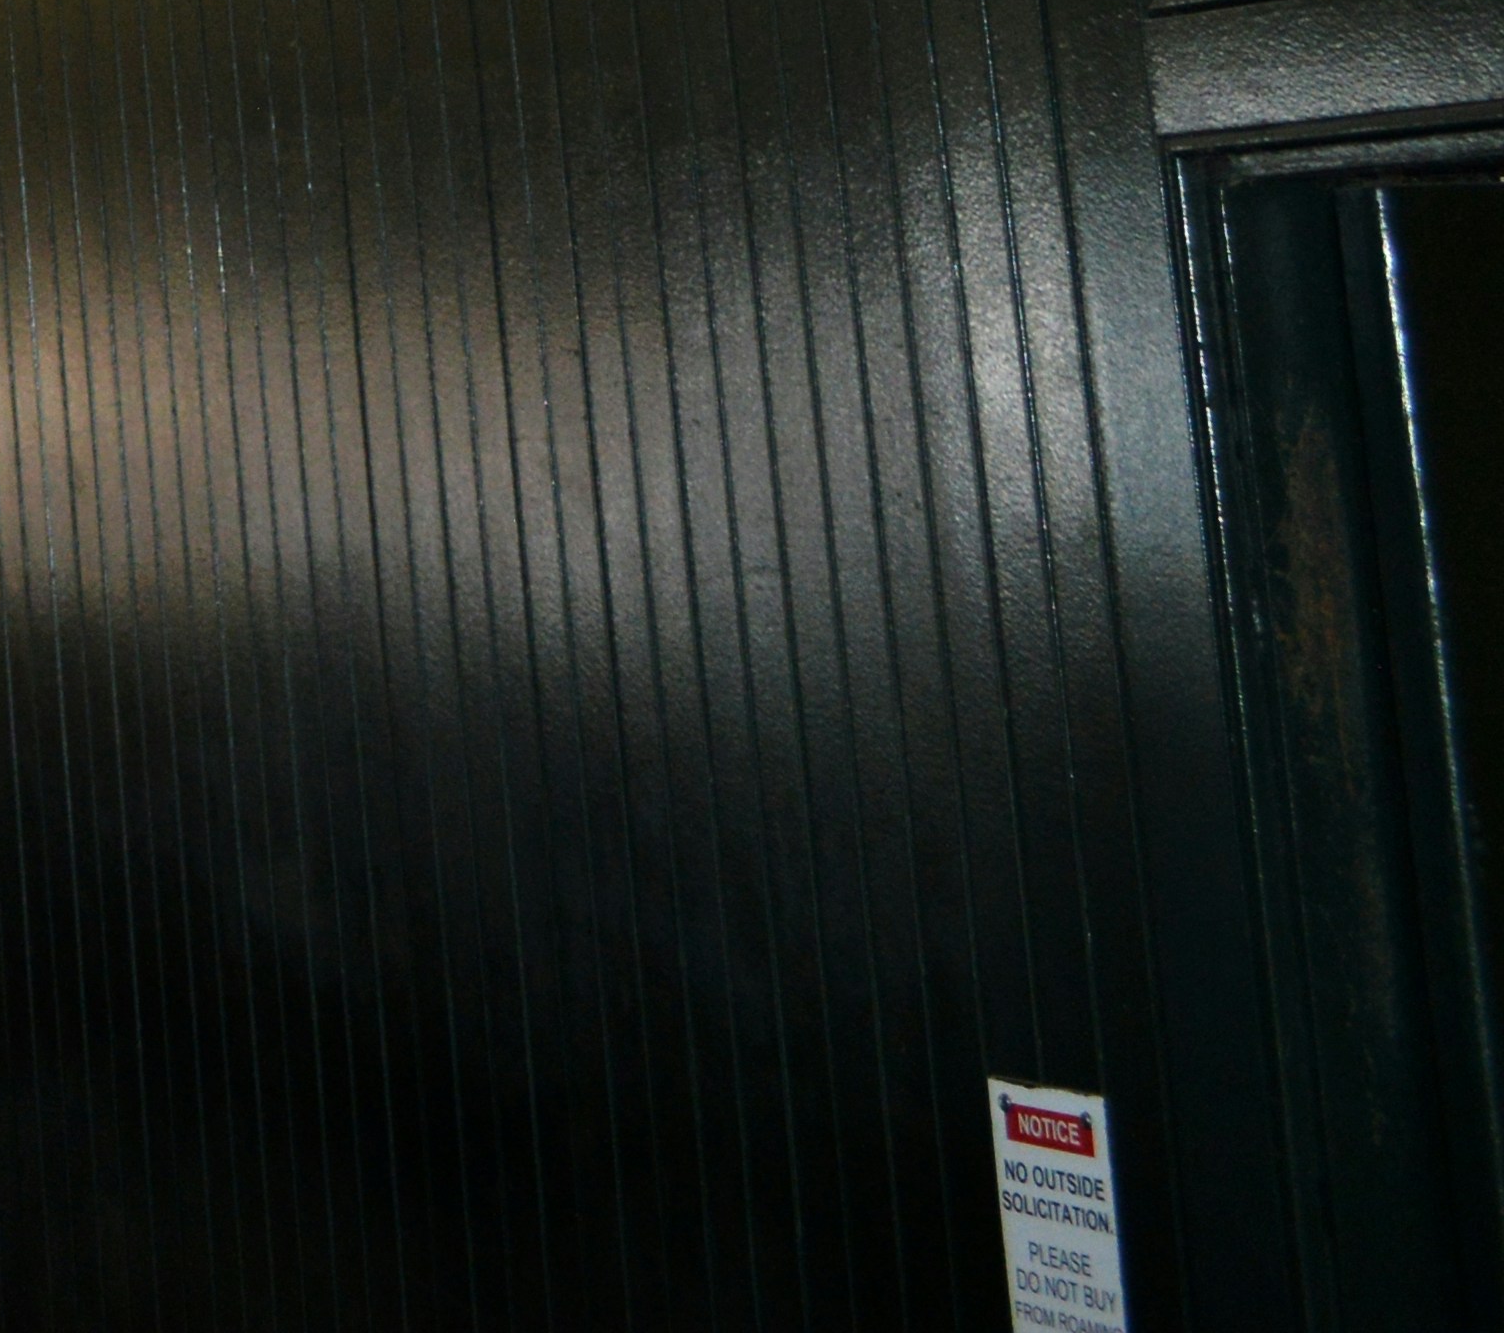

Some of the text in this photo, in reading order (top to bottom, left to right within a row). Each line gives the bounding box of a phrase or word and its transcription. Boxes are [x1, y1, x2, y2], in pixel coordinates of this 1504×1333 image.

[1017, 1112, 1081, 1146] NOTICE
[1004, 1159, 1106, 1202] NO OUTSIDE
[1002, 1190, 1114, 1234] SOLICITATION.
[1028, 1240, 1092, 1278] PLEASE
[1016, 1267, 1116, 1313] DO NOT BUY
[1015, 1301, 1056, 1329] FROM
